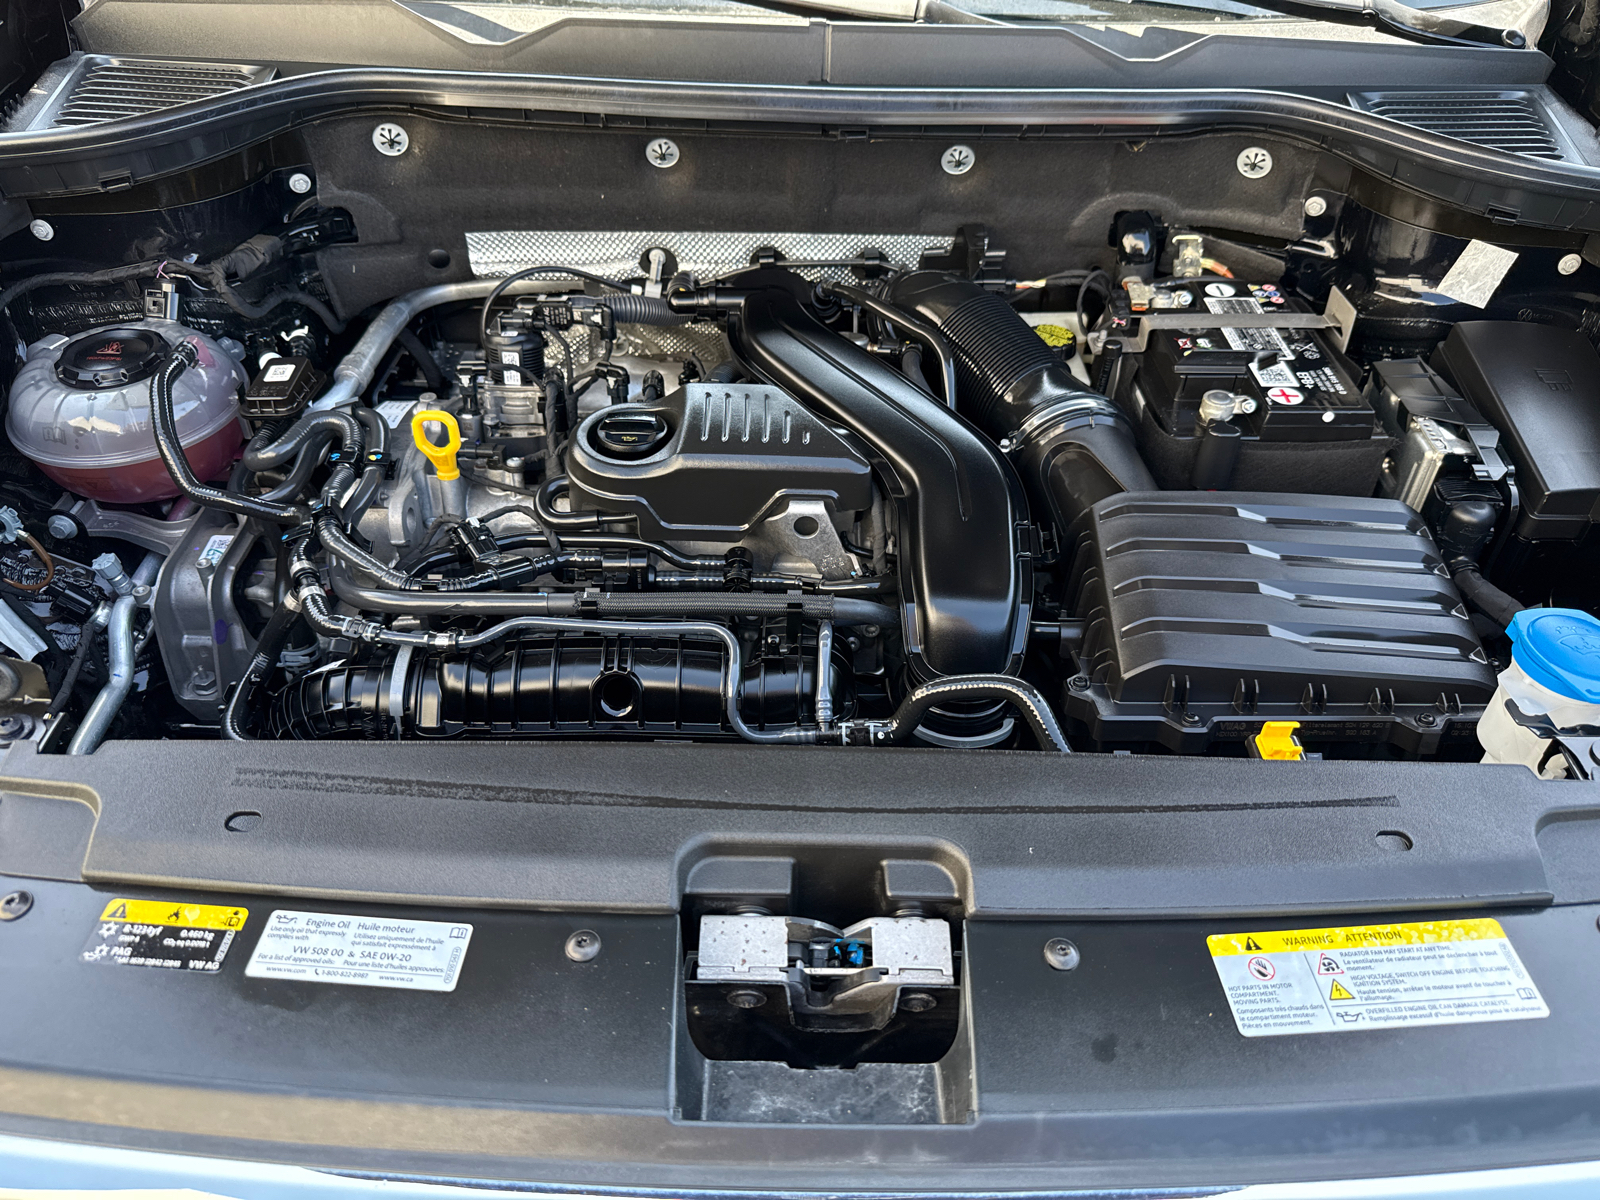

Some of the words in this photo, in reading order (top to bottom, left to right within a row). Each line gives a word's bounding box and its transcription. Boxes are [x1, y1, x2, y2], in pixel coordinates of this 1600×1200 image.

[1296, 370, 1314, 390] EFB+
[306, 918, 336, 928] Engine
[338, 920, 351, 929] Oil
[357, 922, 380, 931] Huile
[382, 924, 415, 934] moteur
[204, 930, 215, 941] kg
[318, 929, 347, 938] expressly
[377, 934, 415, 943] uniquement
[1345, 931, 1402, 942] ATTENTION
[1282, 935, 1334, 946] WARNING
[110, 946, 132, 956] PAG
[293, 945, 310, 954] VW
[311, 947, 329, 955] 508
[331, 949, 344, 957] 00
[388, 942, 431, 951] expressément
[359, 950, 378, 960] SAE
[380, 952, 412, 962] 0W-20
[189, 960, 204, 970] VW
[205, 960, 220, 970] AG
[384, 962, 407, 970] d'huiles
[1236, 1007, 1274, 1015] Composants
[1246, 1013, 1291, 1022] compartiment
